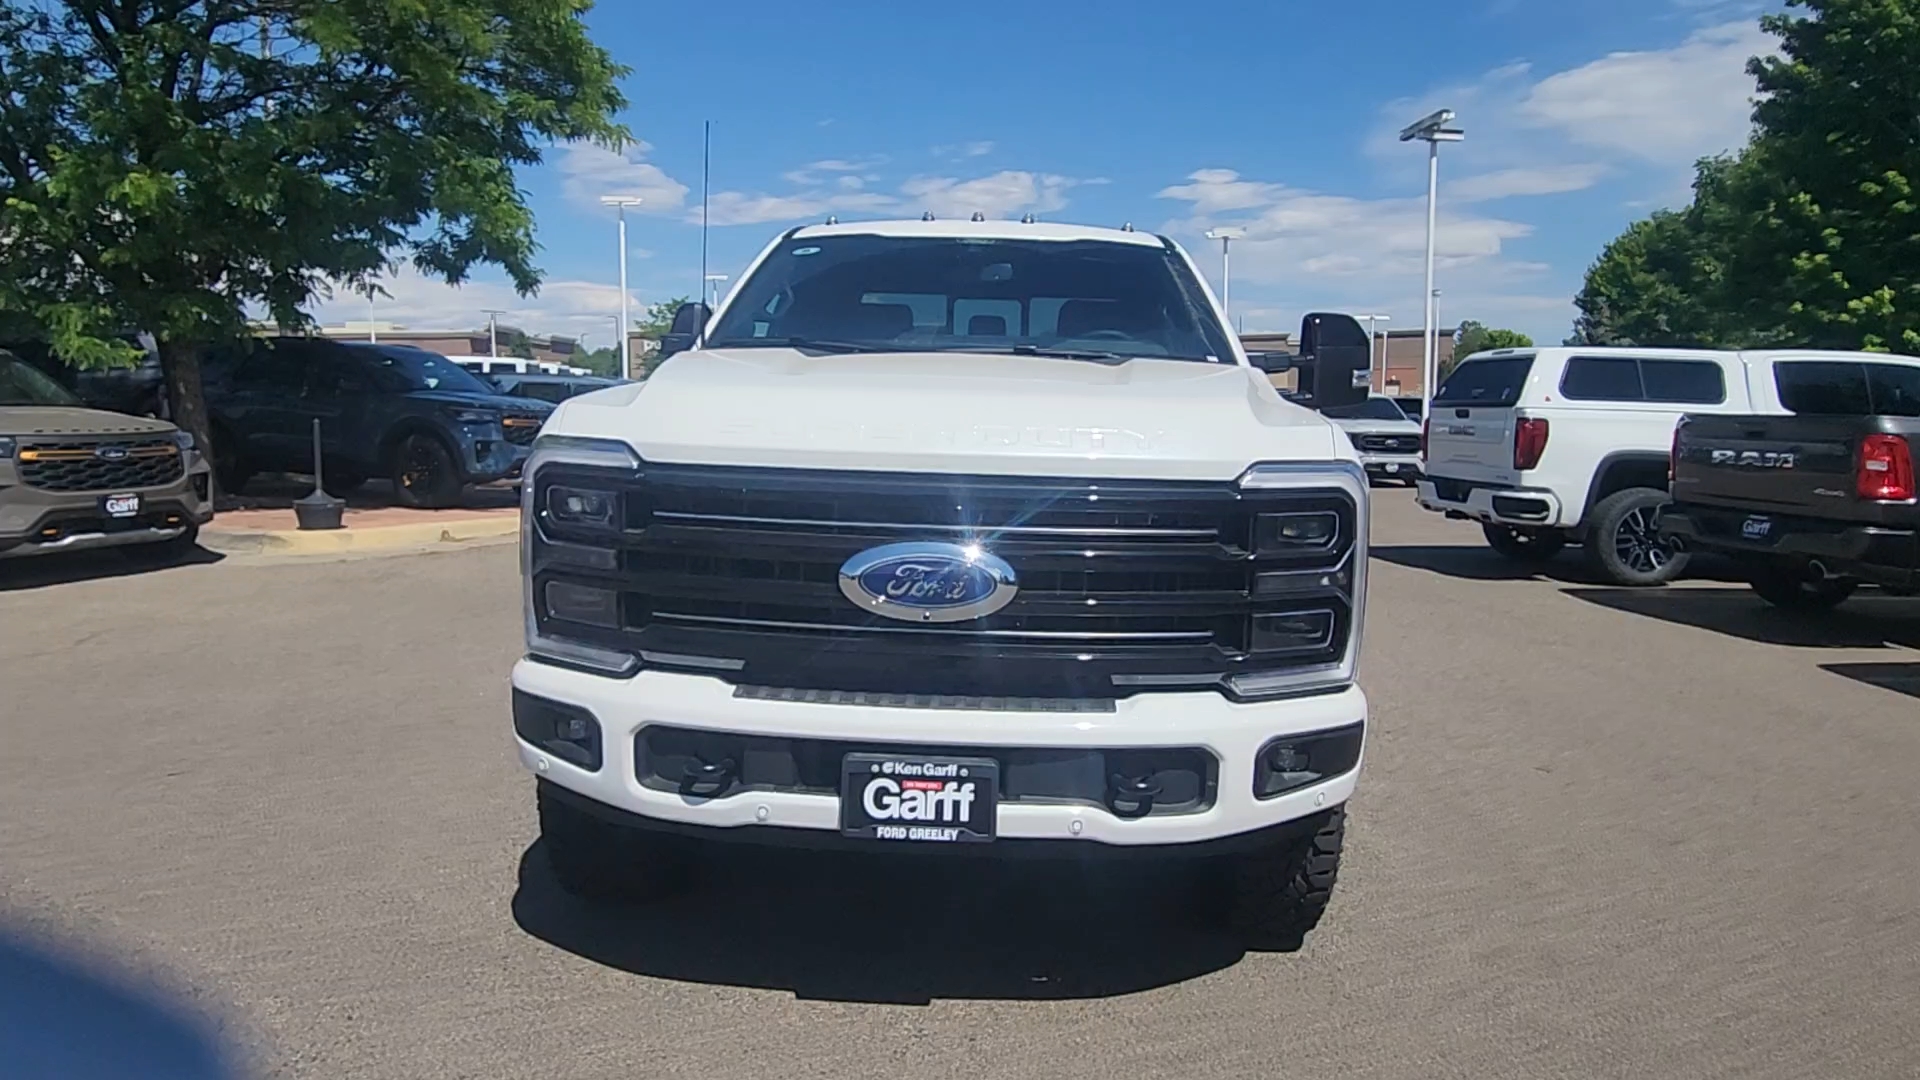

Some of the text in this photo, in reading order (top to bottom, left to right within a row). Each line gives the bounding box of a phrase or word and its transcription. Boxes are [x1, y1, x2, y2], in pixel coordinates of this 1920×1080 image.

[1711, 450, 1795, 469] RAM
[106, 498, 139, 513] Garff
[886, 563, 970, 600] Ford
[895, 762, 958, 777] Ken Garff
[863, 777, 975, 822] Garff
[877, 826, 959, 841] FORD GREELEY
